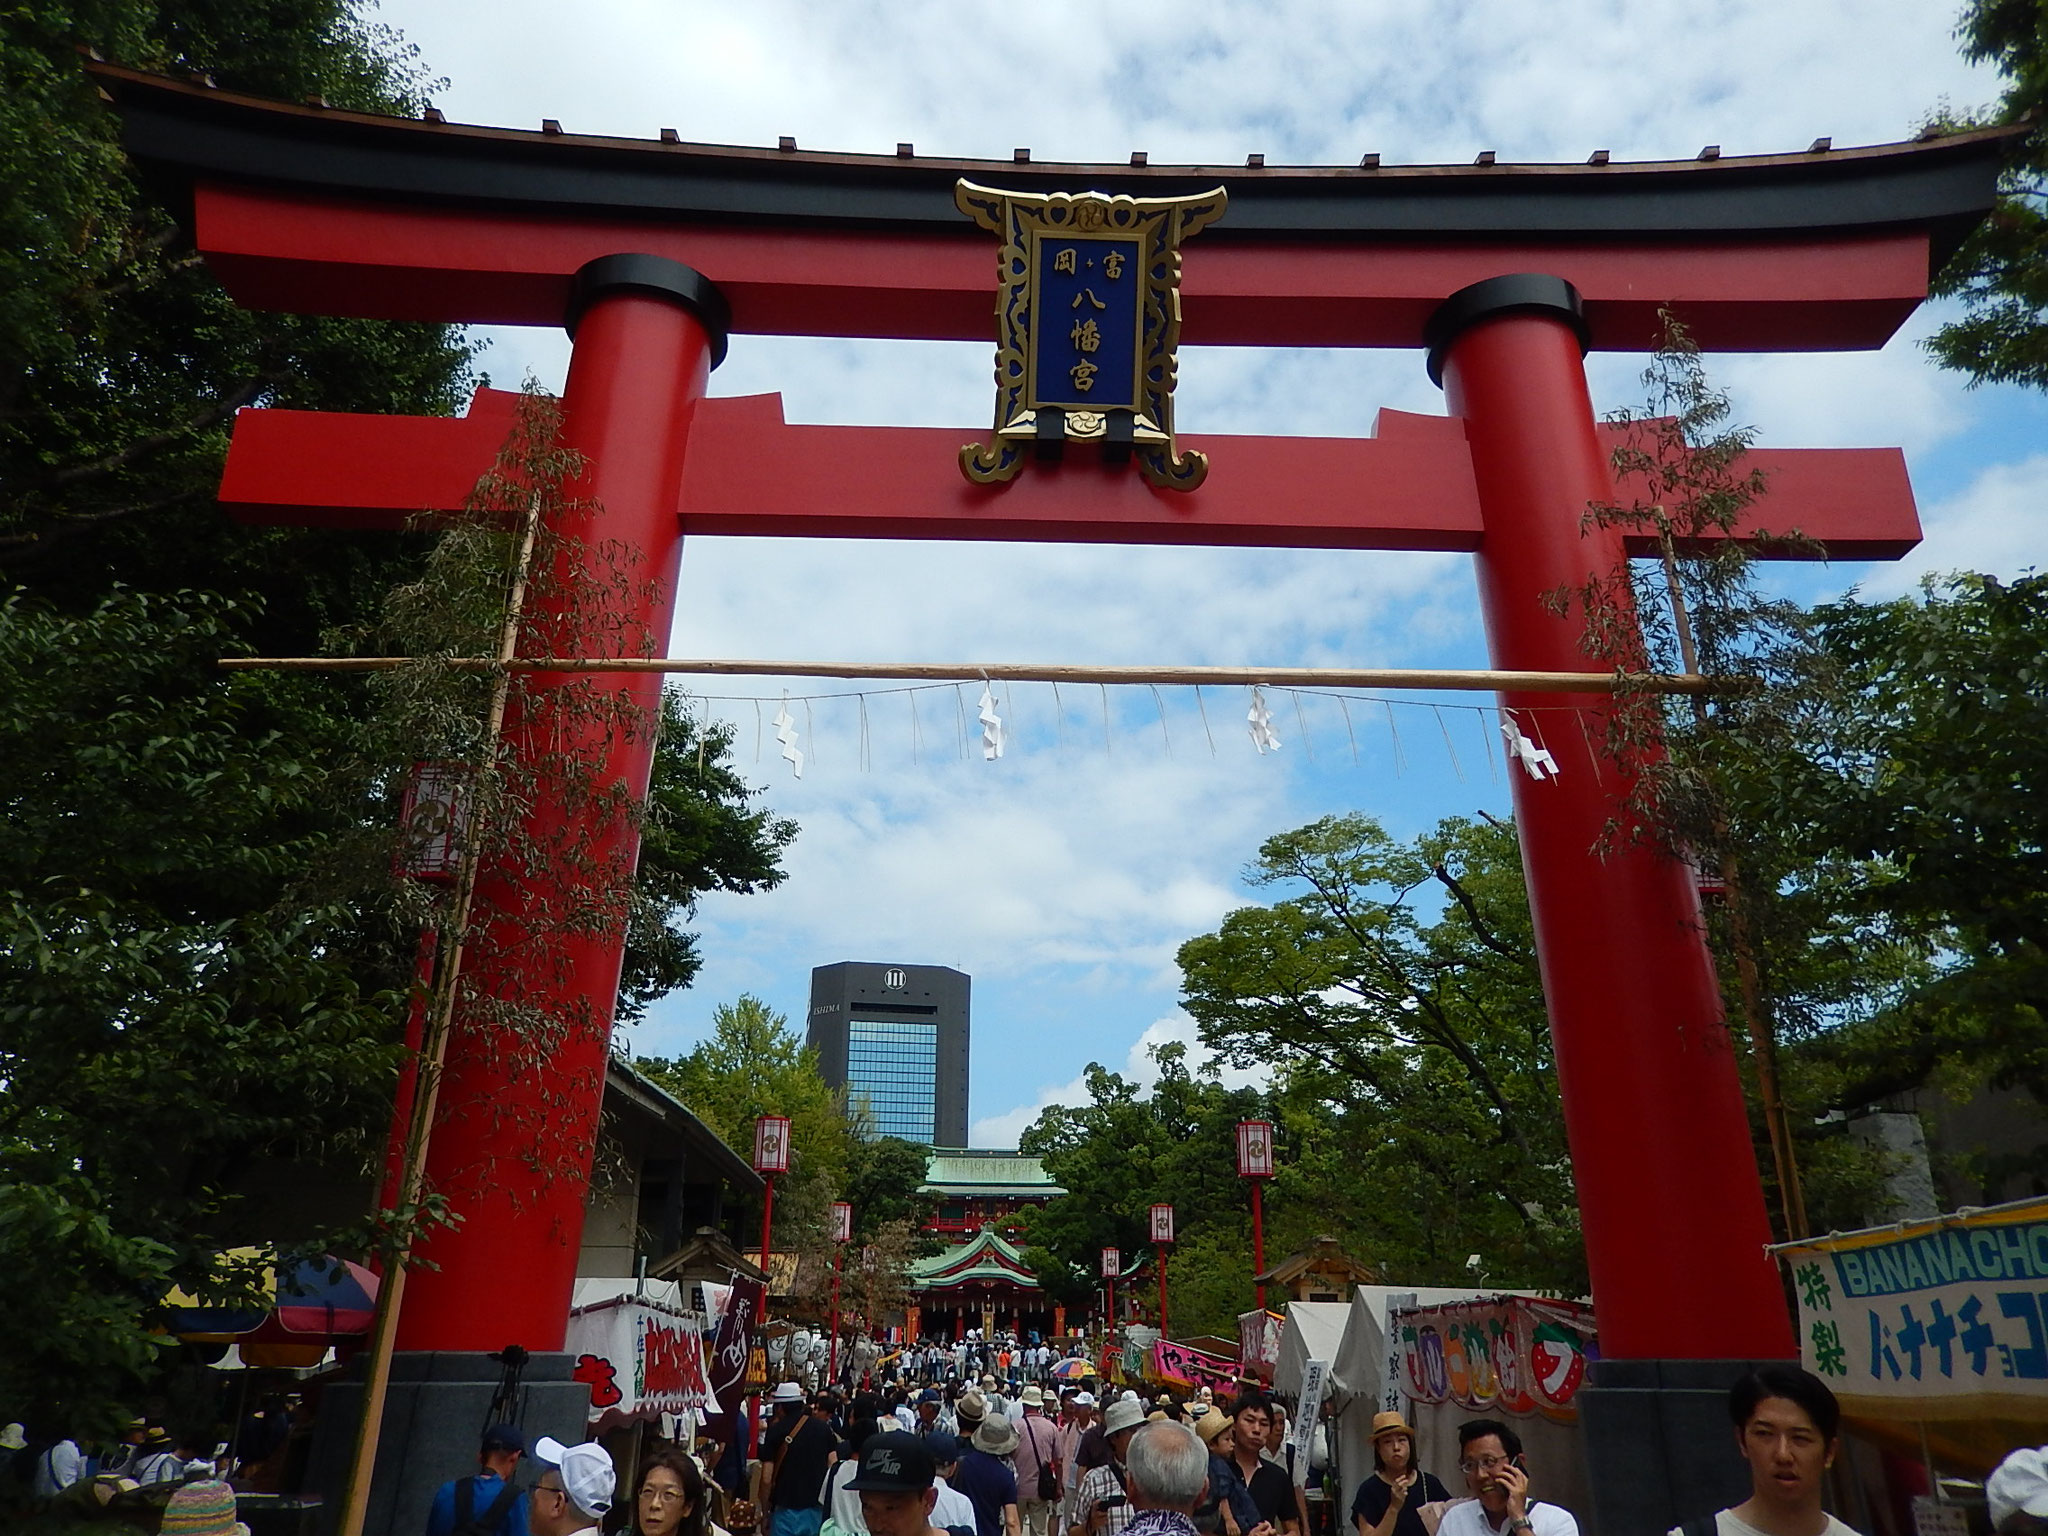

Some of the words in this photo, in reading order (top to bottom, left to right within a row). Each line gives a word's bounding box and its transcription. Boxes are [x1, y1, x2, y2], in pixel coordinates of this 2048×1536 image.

[1796, 1261, 1848, 1378] 特製
[1868, 1291, 2048, 1381] バナナチョコ
[872, 1449, 892, 1460] NIKE
[881, 1462, 901, 1475] AIR
